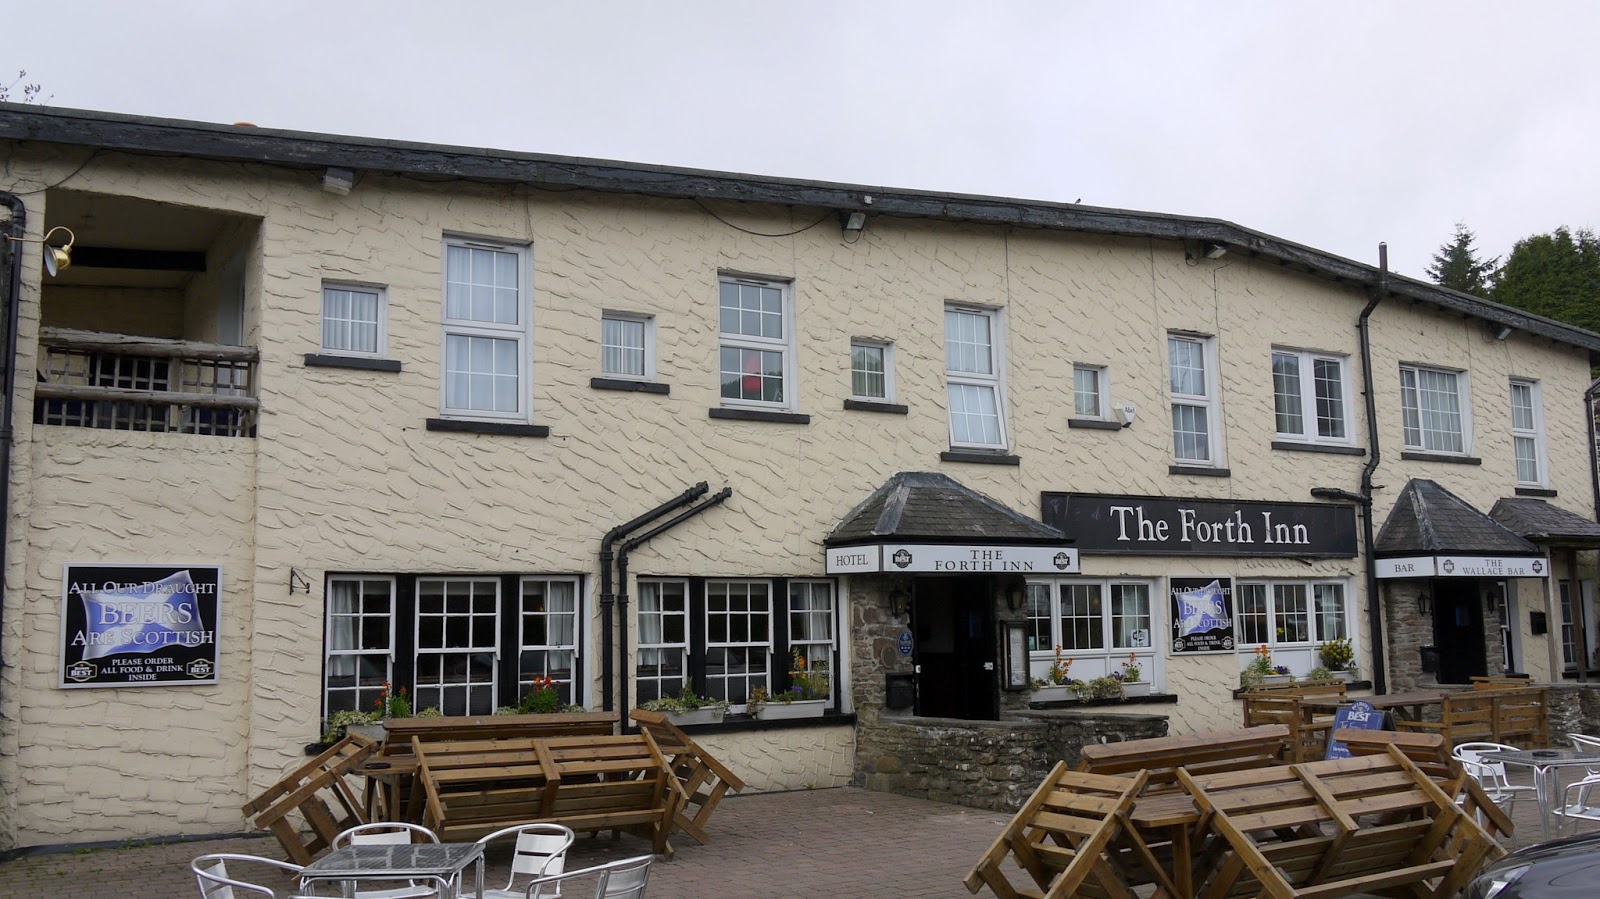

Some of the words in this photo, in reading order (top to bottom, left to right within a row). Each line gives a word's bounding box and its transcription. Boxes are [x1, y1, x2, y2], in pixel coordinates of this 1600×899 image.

[1110, 506, 1168, 541] The
[1178, 508, 1254, 543] Forth
[1262, 511, 1310, 544] Inn
[836, 554, 868, 566] HOTEL
[970, 550, 1003, 560] THE
[935, 560, 993, 570] FORTH
[1003, 561, 1034, 570] INN
[1394, 563, 1415, 573] BAR
[1485, 559, 1503, 567] THE
[1462, 567, 1503, 575] WALLACE
[1508, 567, 1525, 575] BAR
[69, 582, 100, 594] ALL
[103, 581, 139, 594] OUR
[143, 581, 215, 594] DRAUGHT
[99, 602, 192, 625] BEERS
[1194, 618, 1232, 628] COTTISH
[71, 630, 115, 646] ARE
[121, 629, 214, 645] SCOTTISH
[101, 666, 117, 674] ALL
[128, 673, 157, 681] INSIDE
[1347, 711, 1371, 721] BEST
